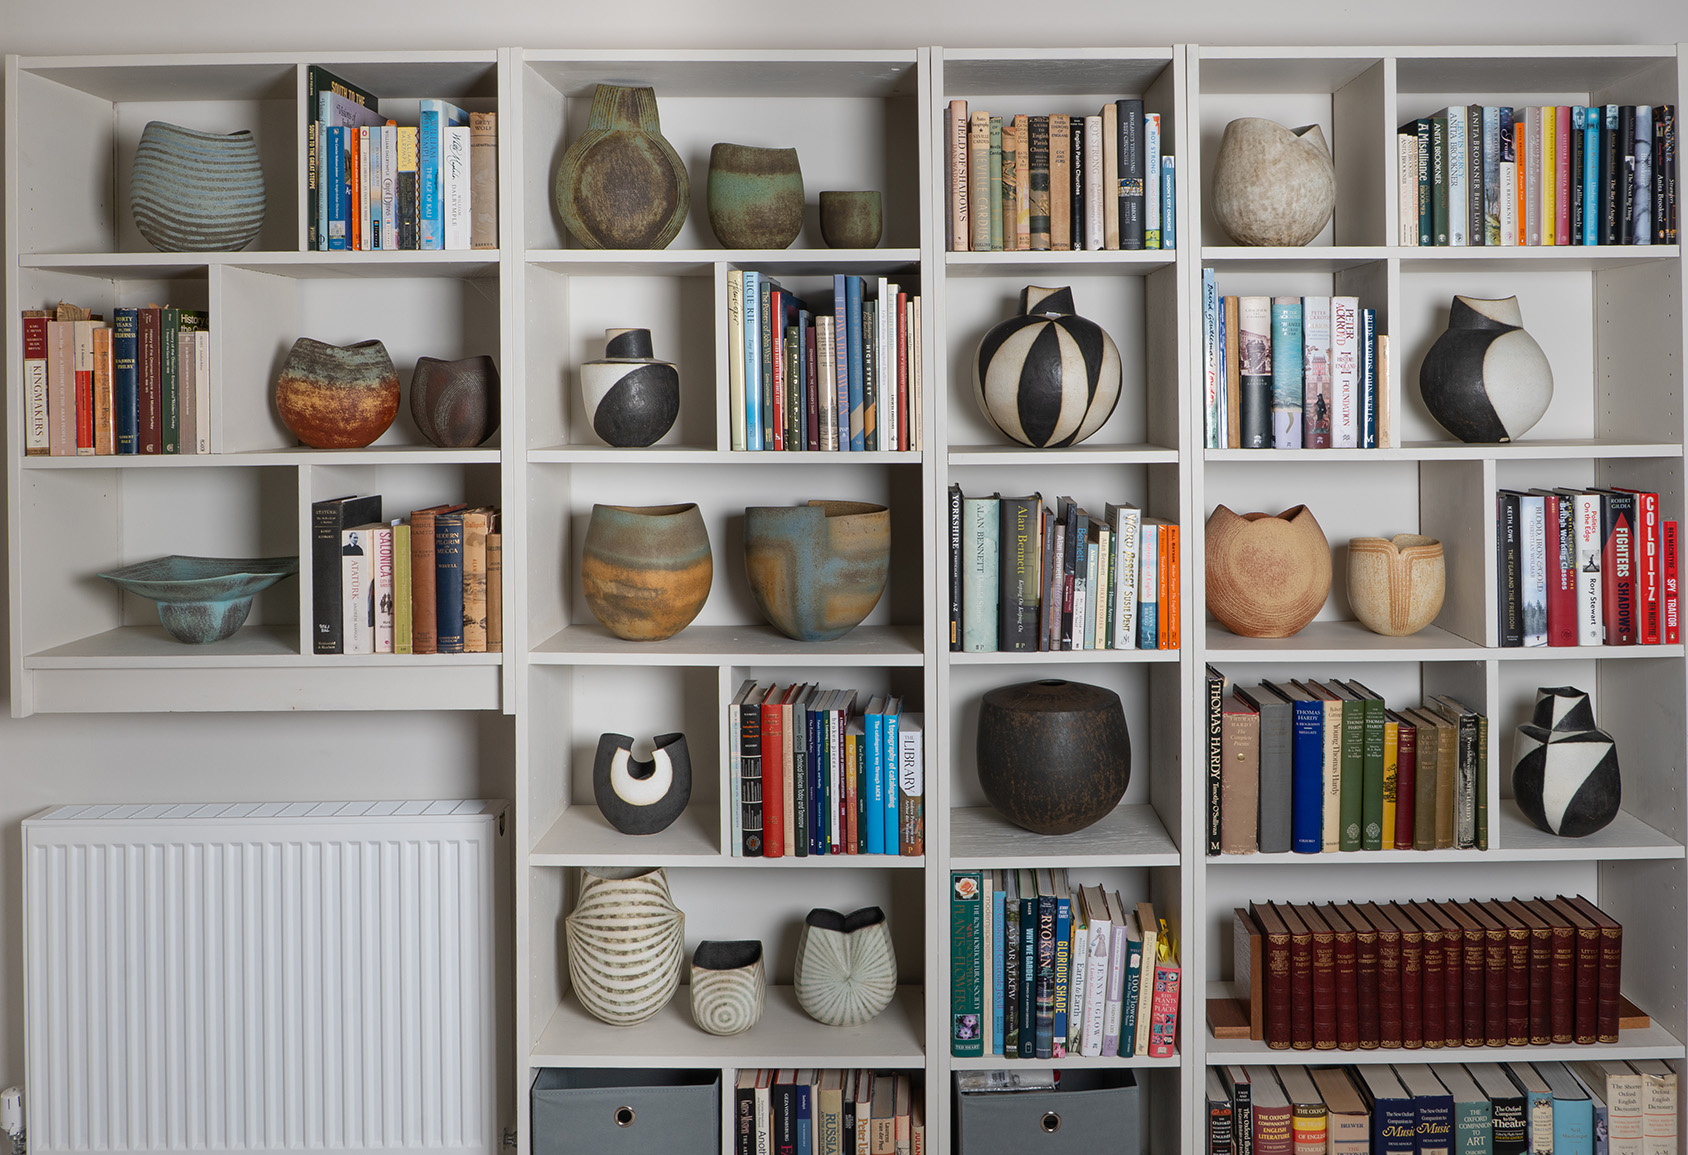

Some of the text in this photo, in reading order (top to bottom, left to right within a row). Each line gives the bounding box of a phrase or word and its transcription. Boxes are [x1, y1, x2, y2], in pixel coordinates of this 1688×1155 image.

[958, 118, 966, 149] FIELD
[1090, 120, 1100, 174] ROY STRONG
[959, 152, 966, 166] OF
[1418, 123, 1429, 181] A Misalliance
[976, 150, 988, 240] NEVILLE CARDUS
[746, 275, 755, 324] LUCIE RIE
[1207, 284, 1215, 311] David
[762, 322, 770, 331] of
[1336, 303, 1345, 346] ACKROYD
[1345, 309, 1354, 339] PETER
[835, 307, 849, 415] EDWARD BAWDEN
[33, 365, 43, 436] KINGMAKERS
[1017, 505, 1027, 531] Alan
[379, 532, 392, 578] SALONICA
[1017, 535, 1027, 574] Bennett
[1077, 528, 1087, 562] Bennett
[1616, 527, 1629, 577] FIGHTERS
[1646, 496, 1655, 601] COLDITZ
[351, 560, 360, 600] ATATÜRK
[1122, 514, 1137, 632] WORD PERFECT SUSIE DENT
[1588, 578, 1597, 595] Rory
[1666, 578, 1676, 592] SPY
[1617, 582, 1630, 633] SHADOWS
[1648, 612, 1656, 636] MACINTYRE
[1668, 599, 1677, 627] TRAITOR
[1018, 624, 1023, 632] On
[1210, 681, 1222, 735] THOMAS
[904, 740, 915, 793] LIBRARY
[1210, 737, 1222, 780] HARDY
[1330, 723, 1341, 796] Young Thomas Hardy
[1211, 782, 1219, 805] Timothy
[954, 905, 966, 1011] PLANTS FLOWERS
[997, 948, 1004, 958] of
[1055, 940, 1066, 1014] GLORIOUS SHADE
[995, 988, 1004, 1009] Jekyll
[1073, 995, 1082, 1017] Earth
[1093, 963, 1104, 1037] JENNY UGLOW
[1129, 995, 1138, 1026] Flowers
[858, 1118, 868, 1142] Peter
[1382, 1126, 1415, 1137] Music
[1416, 1123, 1450, 1134] Music
[1492, 1119, 1526, 1128] Theatre
[1466, 1136, 1486, 1146] ART
